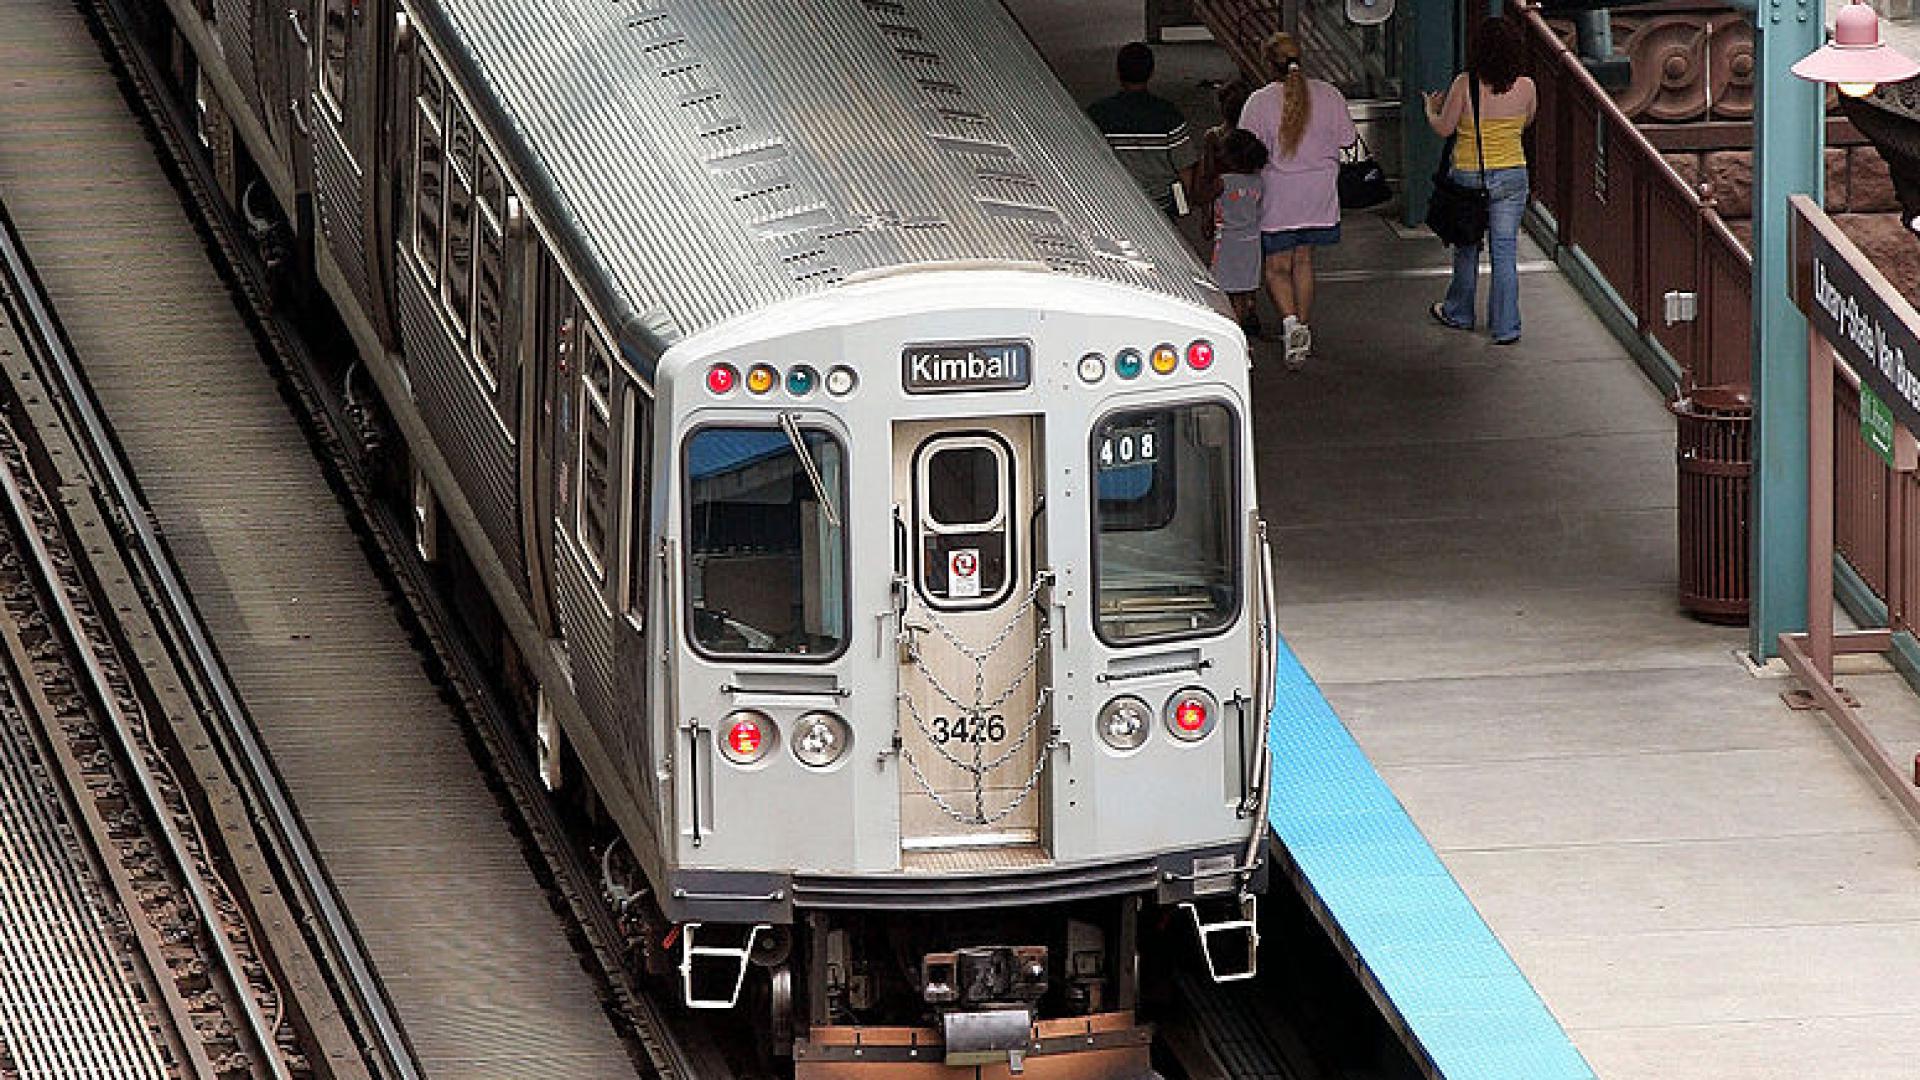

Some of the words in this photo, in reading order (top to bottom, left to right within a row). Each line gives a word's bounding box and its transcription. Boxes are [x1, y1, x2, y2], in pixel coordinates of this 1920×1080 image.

[911, 350, 1017, 381] Kimball
[1101, 433, 1153, 464] 408
[933, 715, 1005, 743] 3426
